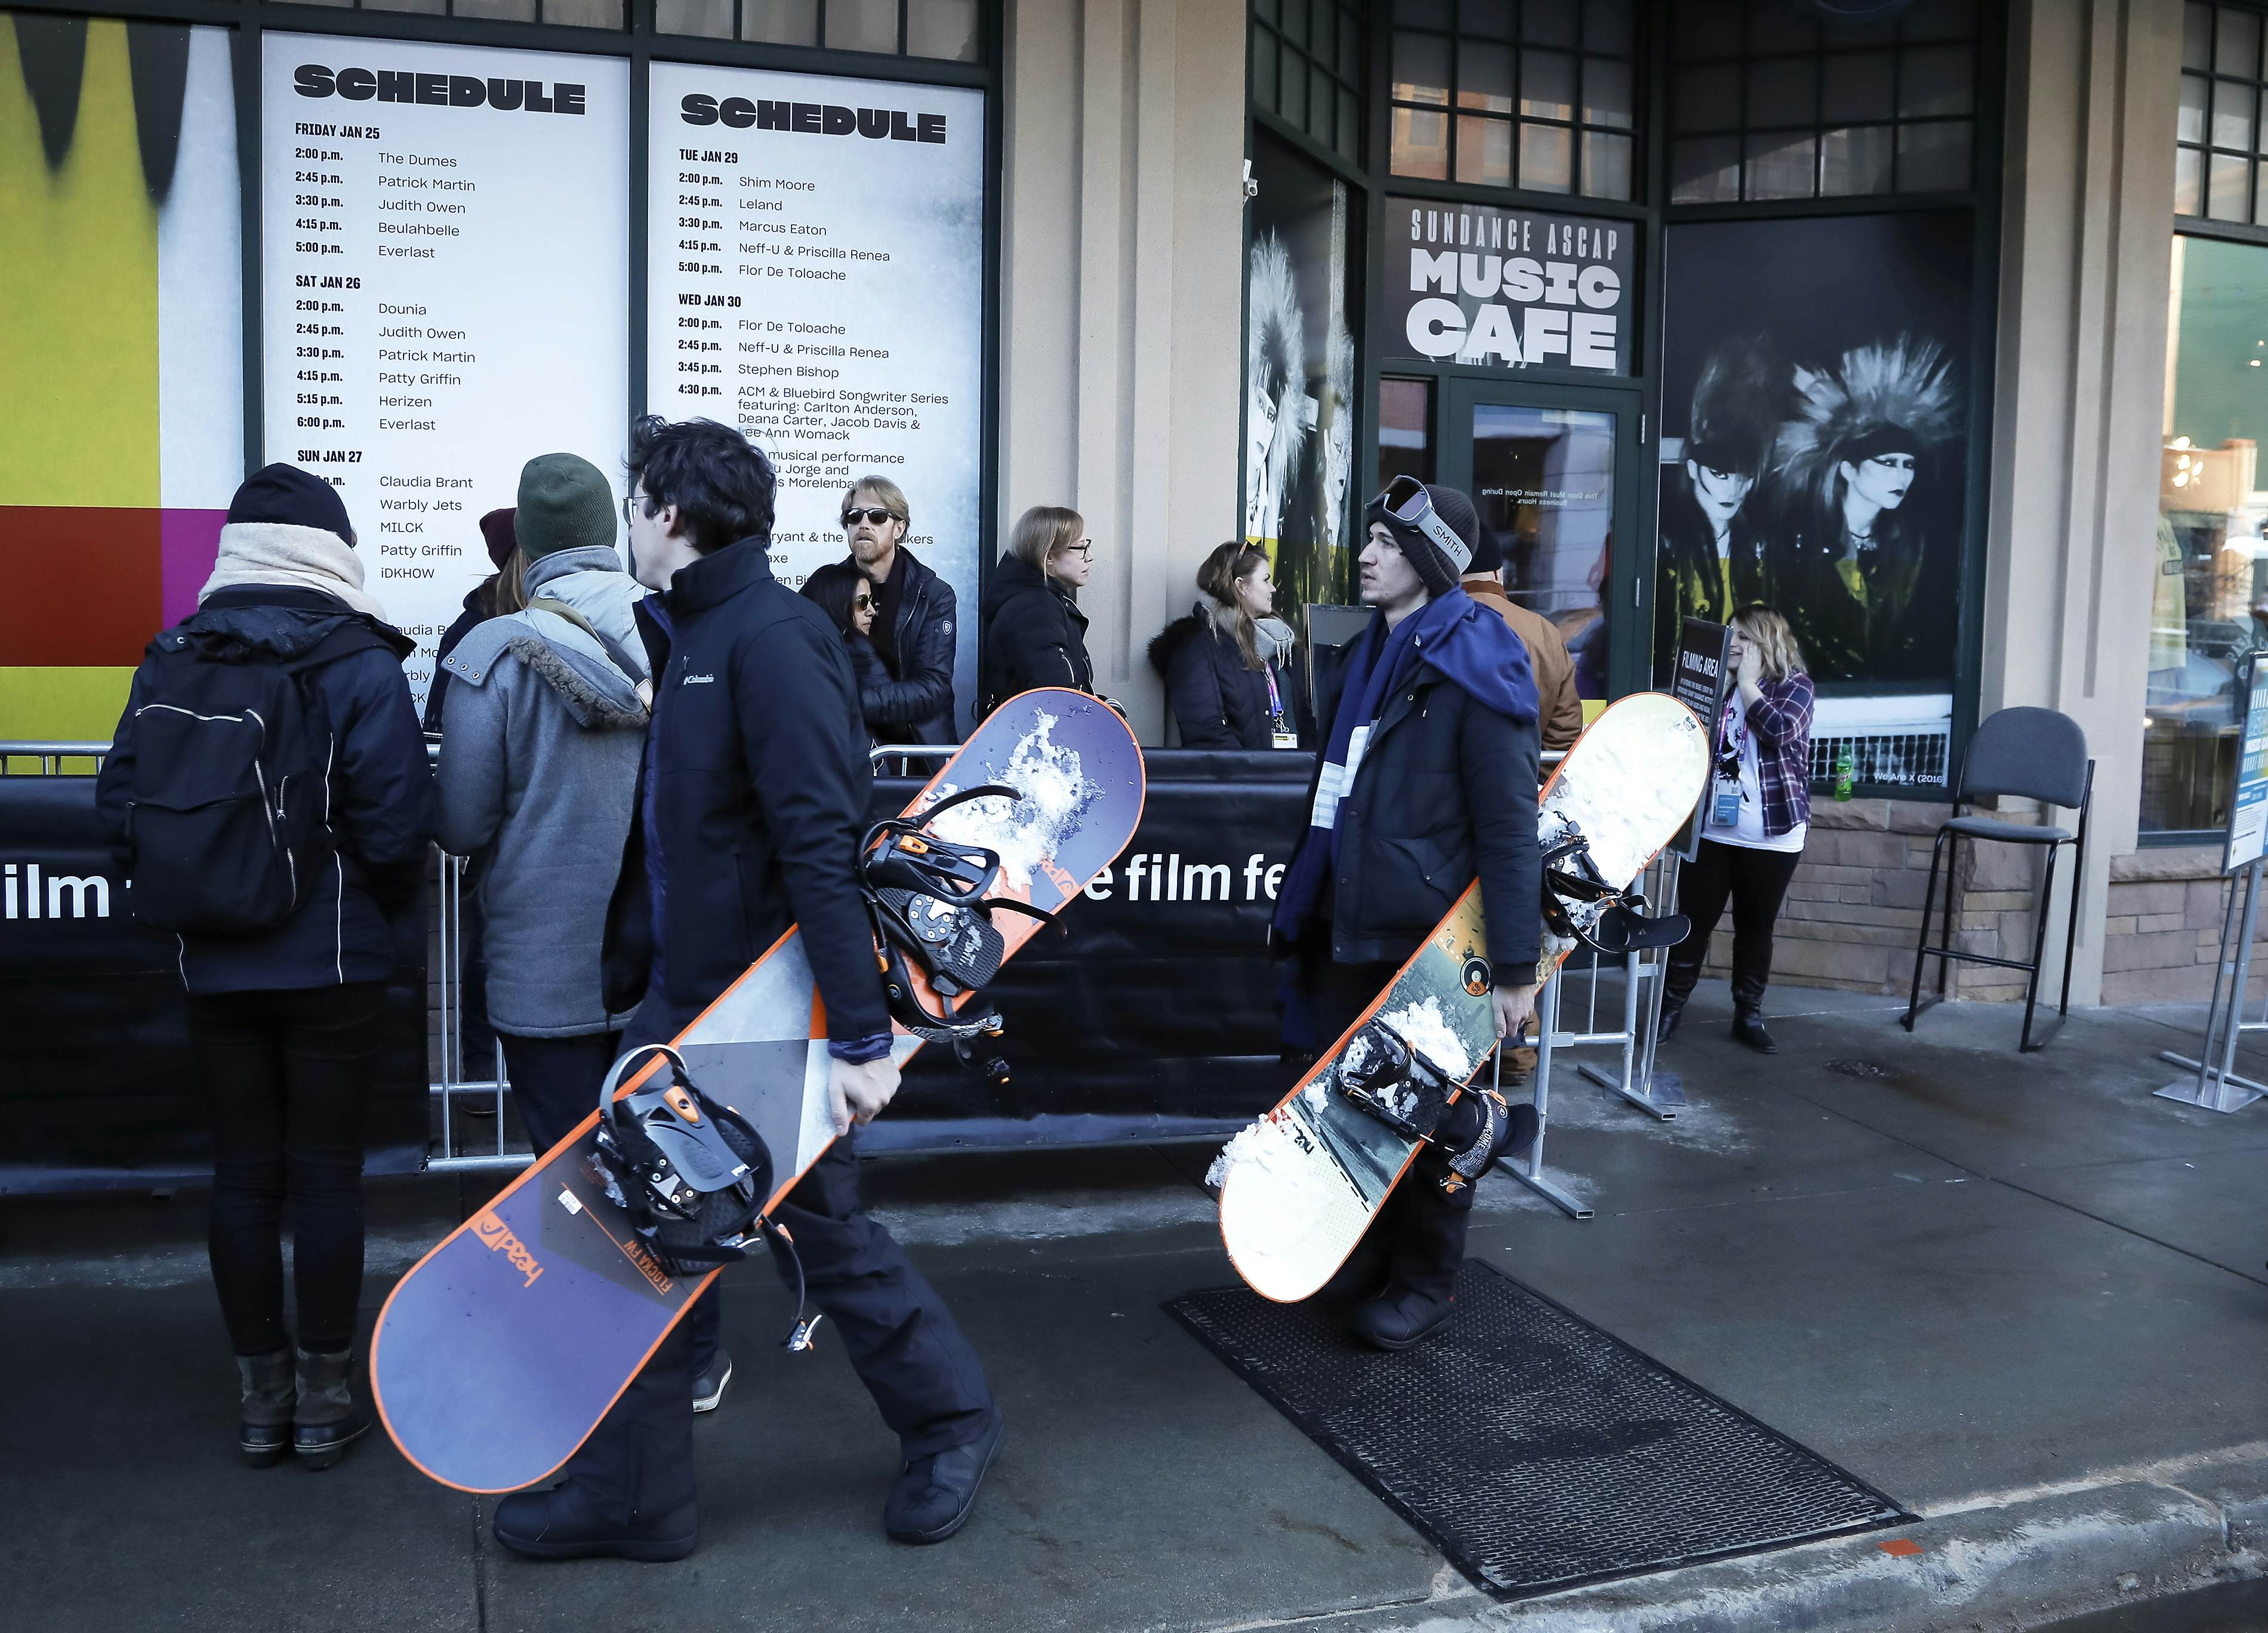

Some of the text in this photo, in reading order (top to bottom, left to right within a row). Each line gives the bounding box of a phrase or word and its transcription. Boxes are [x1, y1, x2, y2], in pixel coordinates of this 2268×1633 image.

[294, 64, 585, 115] SCHEDULE
[680, 94, 946, 144] SCHEDULE
[295, 122, 380, 140] FRIDAY JAN 25
[295, 147, 457, 167] 2:00 p.m. The Dumes
[679, 148, 738, 164] TUE JAN 29
[295, 171, 475, 192] 2:45 p.m. Patrick Martin
[679, 172, 815, 192] 2:00 p.m. Shim Moore
[295, 194, 466, 214] 3:30 p.m. Judith Owen
[679, 195, 782, 211] 2:45 p.m. Leland
[295, 218, 460, 236] 4:15 p.m. Beulahbelle
[679, 217, 827, 236] 3:30 p.m. Marcus Eaton
[1411, 208, 1617, 260] SUNDANCE ASCAP
[295, 241, 435, 258] 5:00 p.m. Everlast
[679, 239, 890, 261] 4:15 p.m. Neff-U & Priscilla Renea
[679, 261, 846, 281] 5:00 p.m. Flor De Toloache
[1410, 248, 1621, 309] MUSIC
[295, 275, 360, 289] SAT JAN 26
[296, 300, 426, 315] 2:00 p.m. Dounia
[678, 293, 741, 308] WED JAN 30
[296, 323, 466, 340] 2:45 p.m. Judith Owen
[678, 317, 846, 335] 2:00 p.m. Flor De Toloache
[1406, 297, 1617, 369] CAFE
[296, 346, 475, 363] 3:30 p.m. Patrick Martin
[678, 339, 889, 359] 2:45 p.m. Neff-U & Priscilla Renea
[297, 370, 461, 387] 4:15 p.m. Patty Griffin
[678, 361, 839, 380] 3:45 p.m. Stephen Bishop
[297, 393, 432, 407] 5:15 p.m. Herizen
[678, 384, 948, 404] 4:30 p.m. ACM & Bluebird Songwriter Series
[738, 399, 917, 417] featuring: Carlton Anderson,
[297, 416, 436, 430] 6:00 p.m. Everlast
[738, 413, 920, 430] Deana Carter, Jacob Davis &
[765, 428, 790, 438] Ann
[794, 429, 850, 440] Womack
[297, 449, 362, 463] SUN JAN 27
[768, 451, 905, 464] musical performance
[785, 464, 821, 477] Jorge
[825, 465, 849, 475] and
[380, 476, 473, 488] Claudia Brant
[788, 477, 855, 489] Morelenba
[380, 499, 462, 513] Warbly Jets
[381, 522, 423, 533] MILCK
[771, 532, 844, 544] ryant & the
[1432, 525, 1462, 557] SMITH
[381, 544, 462, 558] Patty Griffin
[381, 566, 435, 578] iDKHOW
[1682, 650, 1719, 678] FILMING AREA
[1891, 773, 1907, 781] Are
[1909, 774, 1915, 782] X
[1918, 775, 1943, 784] (2016
[1124, 854, 1231, 901] film
[4, 864, 110, 919] ilm
[1471, 983, 1481, 994] 58
[623, 1239, 643, 1259] FW
[494, 1230, 545, 1289] head
[639, 1253, 674, 1294] FLOCKA
